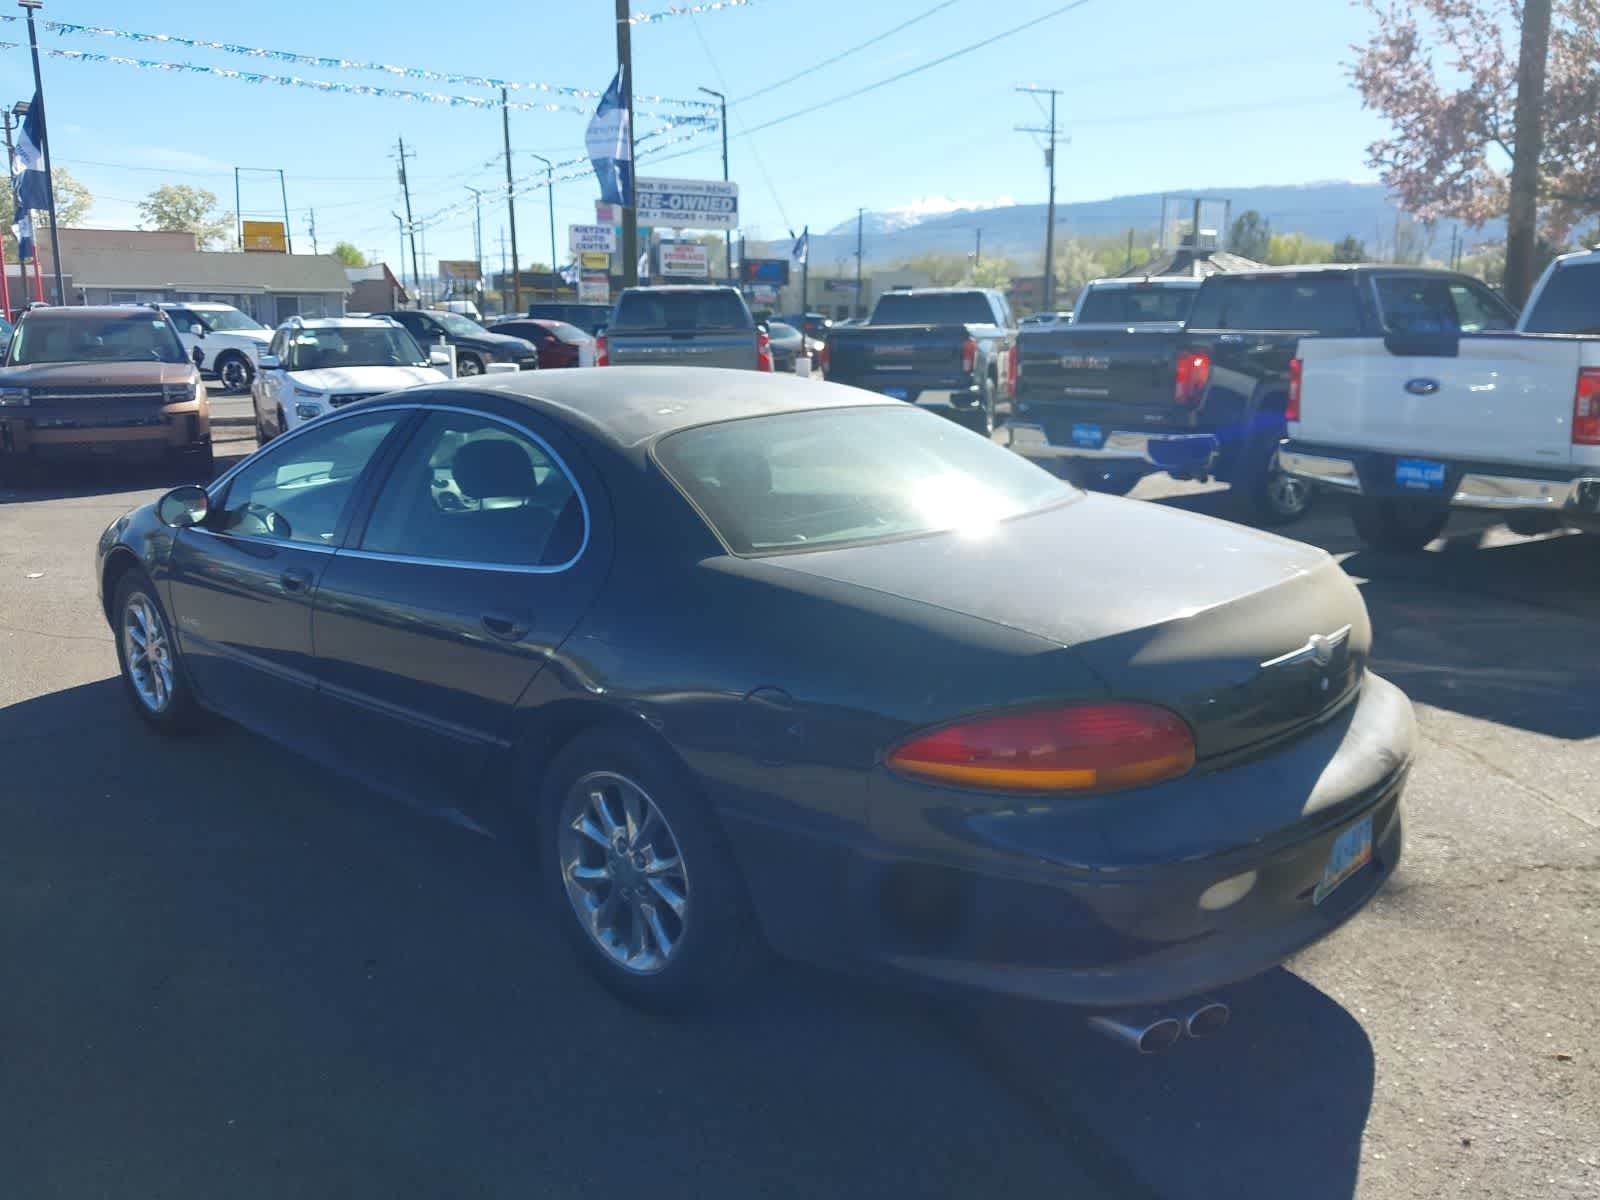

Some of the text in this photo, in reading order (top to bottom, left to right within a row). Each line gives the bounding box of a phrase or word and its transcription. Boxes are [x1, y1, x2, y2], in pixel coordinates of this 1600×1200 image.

[638, 193, 734, 212] RE-OWNED
[661, 212, 696, 221] TRUCKS
[576, 243, 609, 251] CENTER
